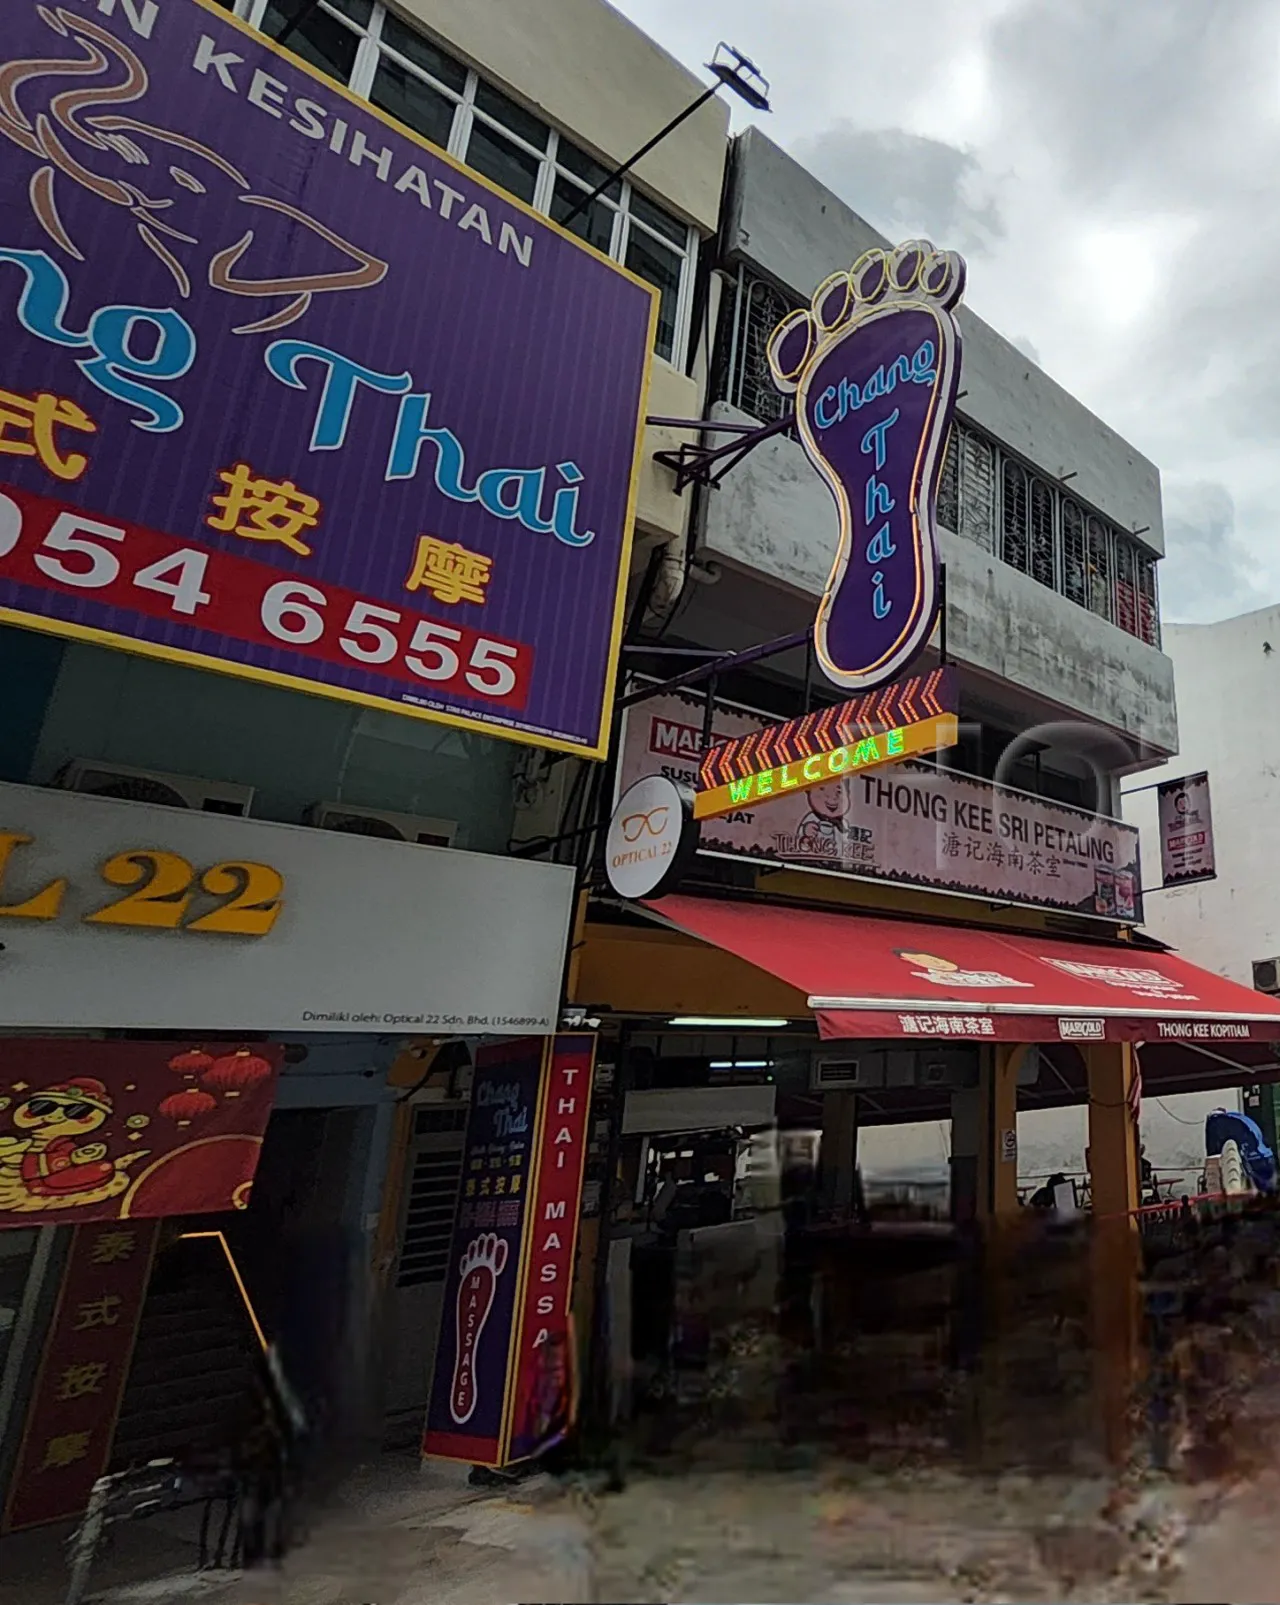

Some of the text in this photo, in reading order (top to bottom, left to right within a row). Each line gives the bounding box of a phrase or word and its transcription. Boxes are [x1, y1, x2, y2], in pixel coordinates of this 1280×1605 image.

[193, 34, 533, 267] KESIHATAN
[814, 339, 936, 430] Chang
[265, 338, 595, 547] Thai
[860, 408, 900, 620] Thai
[259, 581, 518, 697] 6555
[728, 727, 906, 803] WELCOME
[612, 847, 658, 868] OPTICAL
[770, 831, 838, 857] THONG
[860, 772, 1115, 864] THONG KEE SRI PETALING
[942, 832, 1061, 878] 溏记海南茶室
[84, 850, 284, 936] 22
[302, 1011, 349, 1022] Dimiliki
[351, 1012, 381, 1023] oleh:
[383, 1013, 423, 1025] Optical
[425, 1014, 439, 1025] 22
[1159, 1022, 1250, 1038] THONG KEE KOPITIAM
[554, 1069, 579, 1168] THAI
[458, 1276, 481, 1407] MASSAGE
